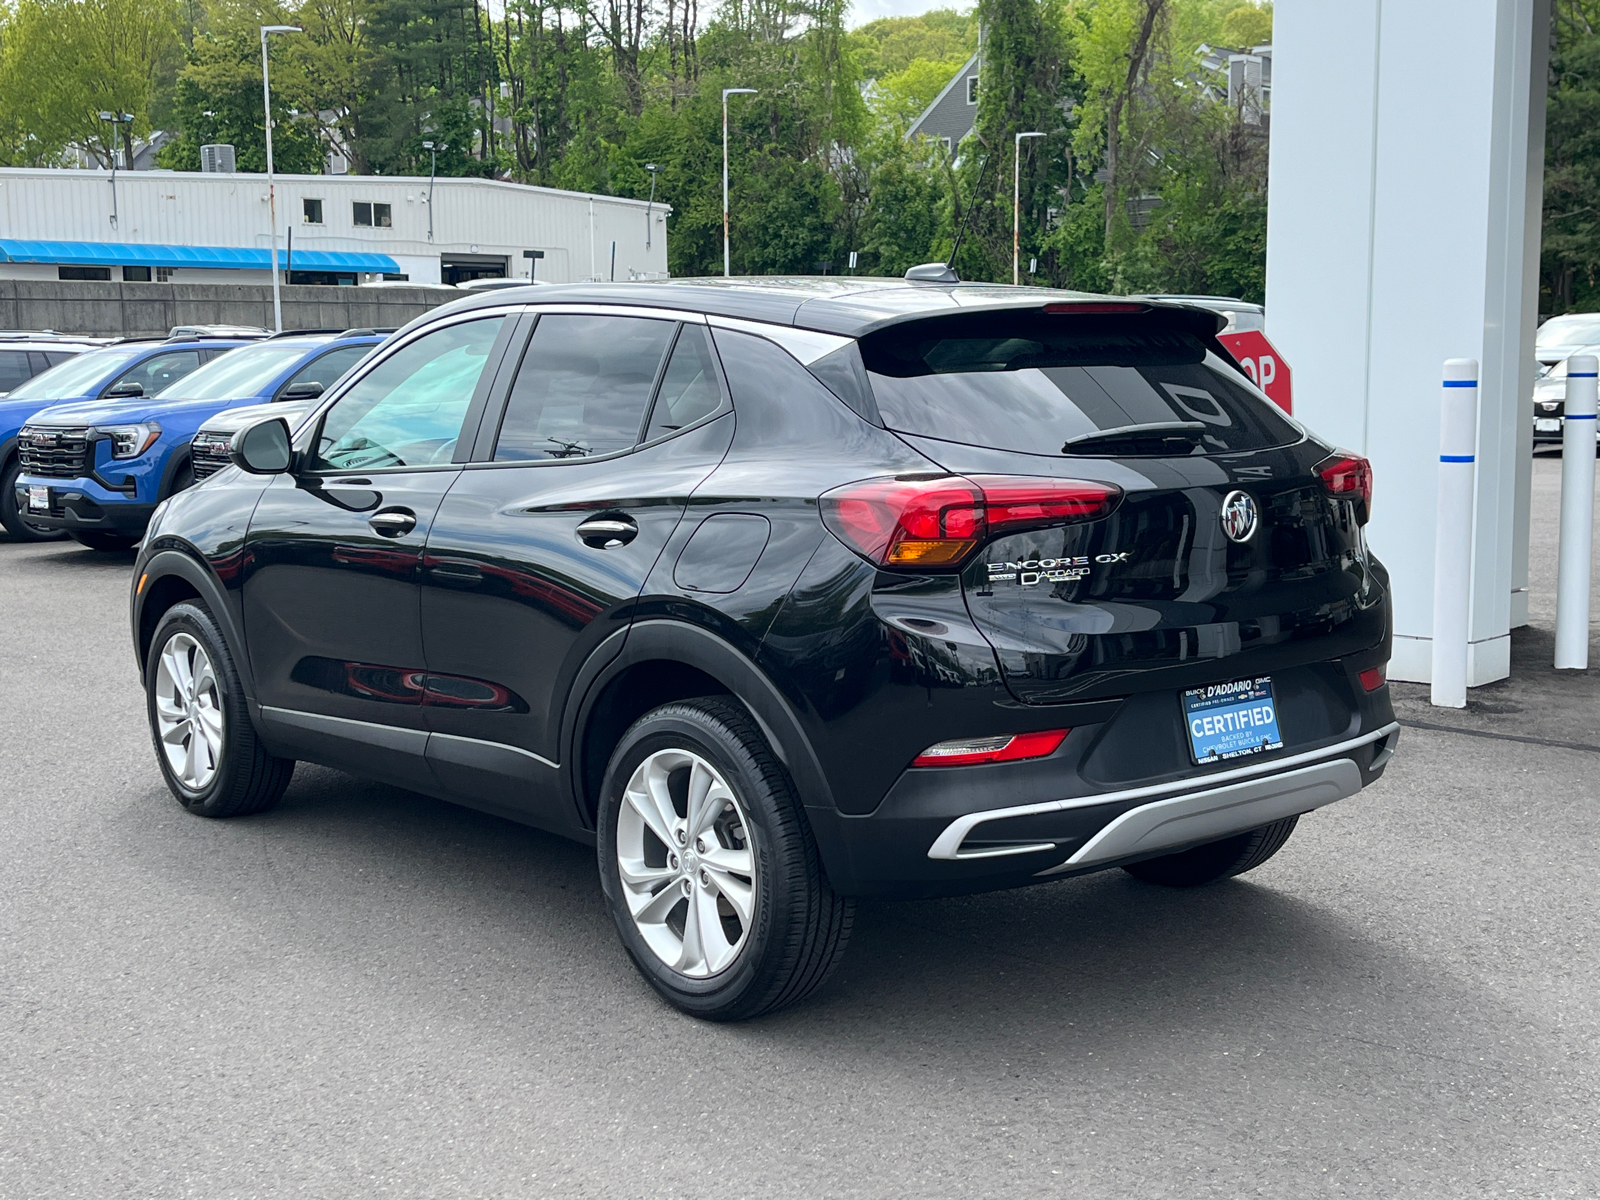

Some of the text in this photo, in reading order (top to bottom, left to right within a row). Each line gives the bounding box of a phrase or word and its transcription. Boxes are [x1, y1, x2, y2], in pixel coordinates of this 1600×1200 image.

[987, 552, 1128, 572] ENCORE GX
[1185, 676, 1271, 697] BUICK D'ADDARIO GMC
[1191, 706, 1274, 738] CERTIFIED
[1202, 740, 1237, 753] CHEVROLET
[1237, 737, 1256, 746] BUICK
[1221, 732, 1245, 742] BACKED
[1198, 755, 1219, 765] NISSAN
[1222, 749, 1254, 760] SHELTON,
